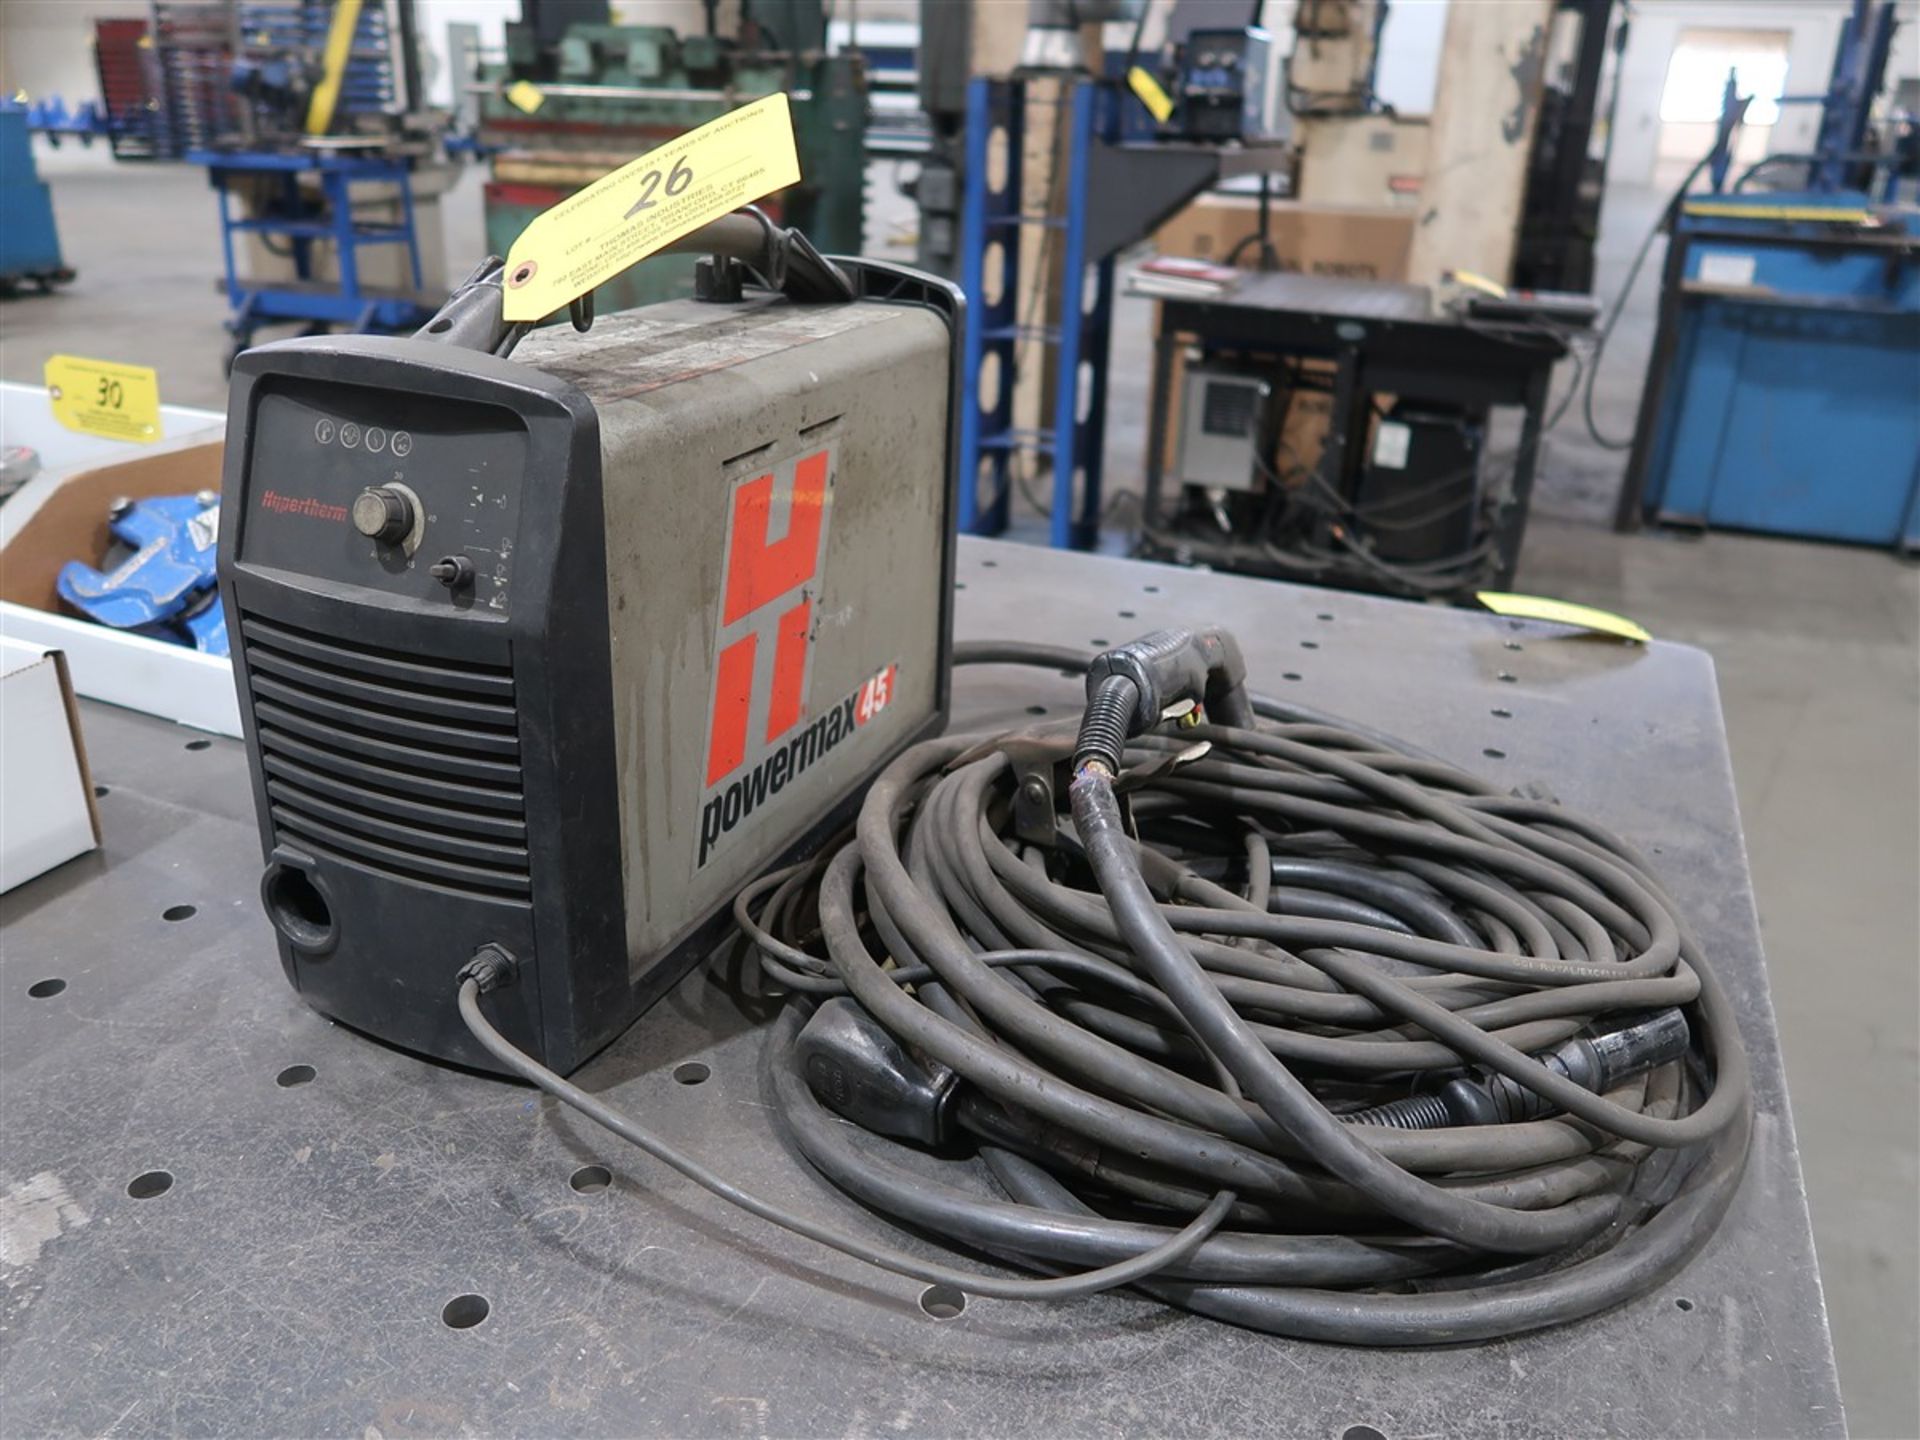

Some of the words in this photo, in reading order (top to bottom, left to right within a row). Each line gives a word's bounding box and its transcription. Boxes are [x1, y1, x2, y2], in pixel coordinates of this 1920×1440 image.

[697, 131, 710, 141] OF
[713, 105, 763, 134] AUCTIONS
[623, 155, 694, 220] 26
[600, 220, 644, 249] THOMAS
[645, 182, 713, 222] INDUSTRIES
[568, 258, 593, 277] EAST
[594, 244, 617, 261] MAIN
[97, 377, 124, 409] 30
[262, 490, 348, 522] Hypertherm
